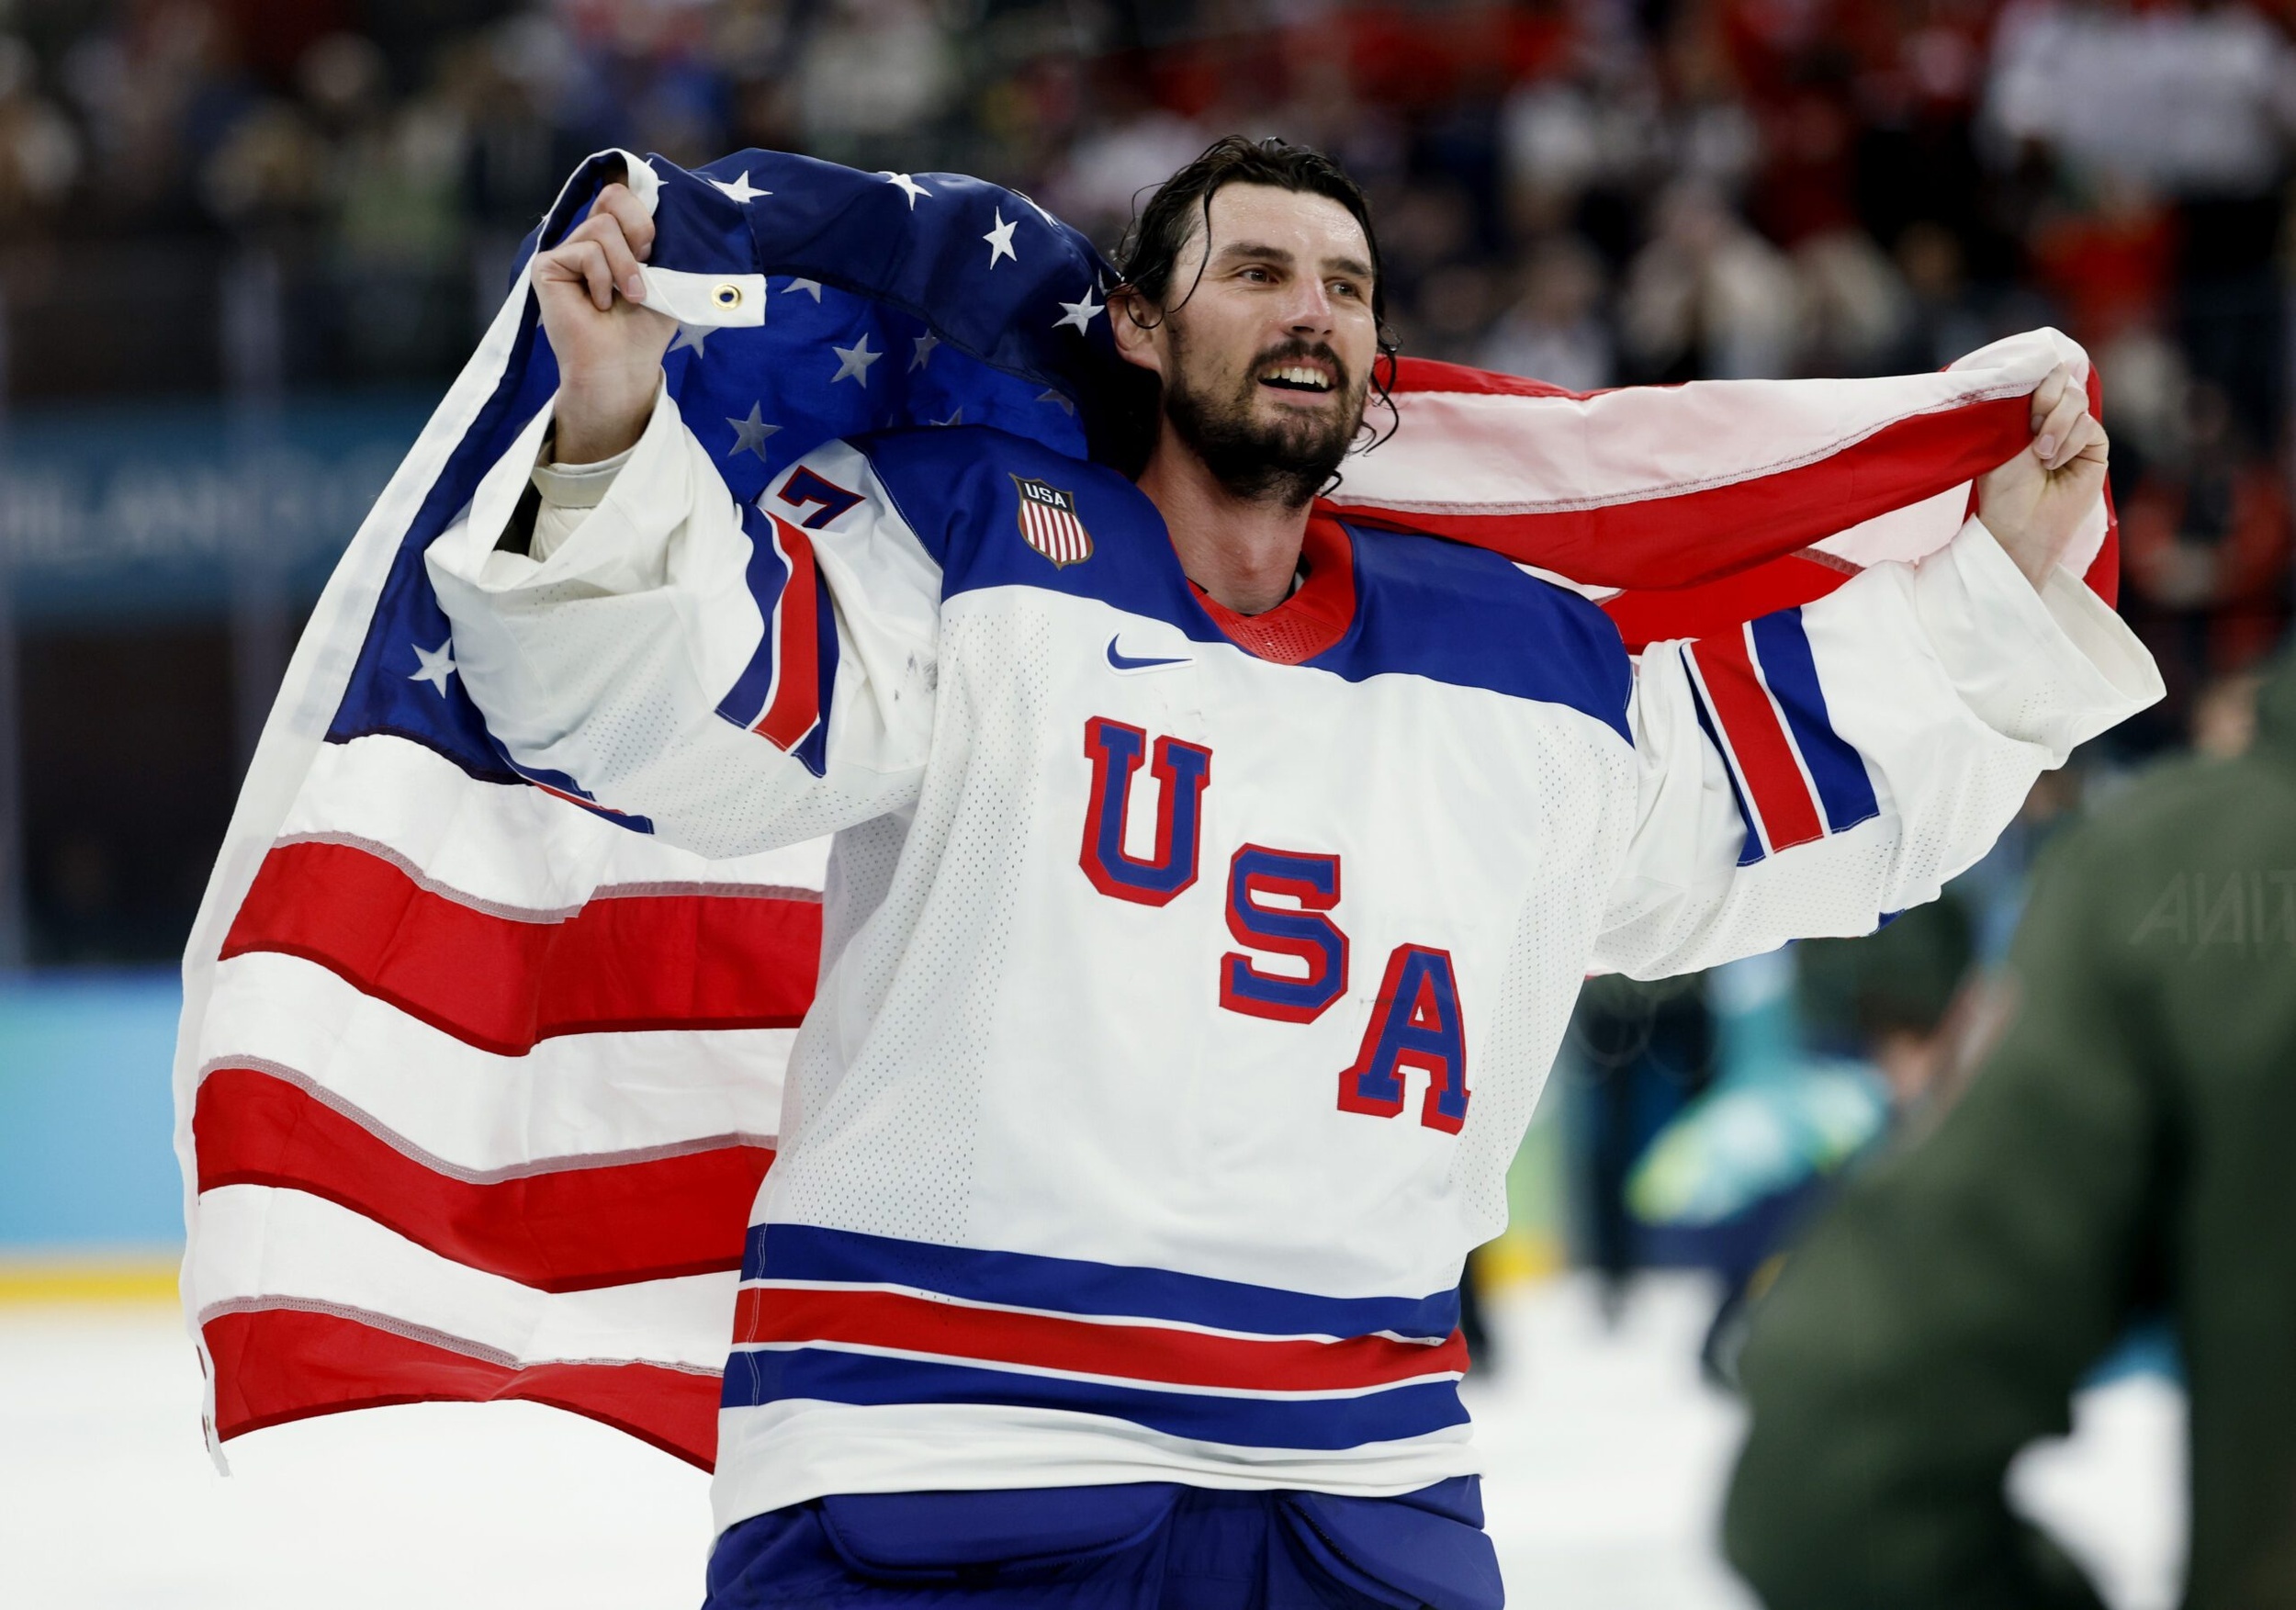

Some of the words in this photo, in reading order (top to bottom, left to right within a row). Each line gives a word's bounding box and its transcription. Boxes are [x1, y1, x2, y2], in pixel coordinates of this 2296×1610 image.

[776, 464, 866, 530] 7
[1024, 482, 1067, 509] USA
[1078, 715, 1471, 1136] USA
